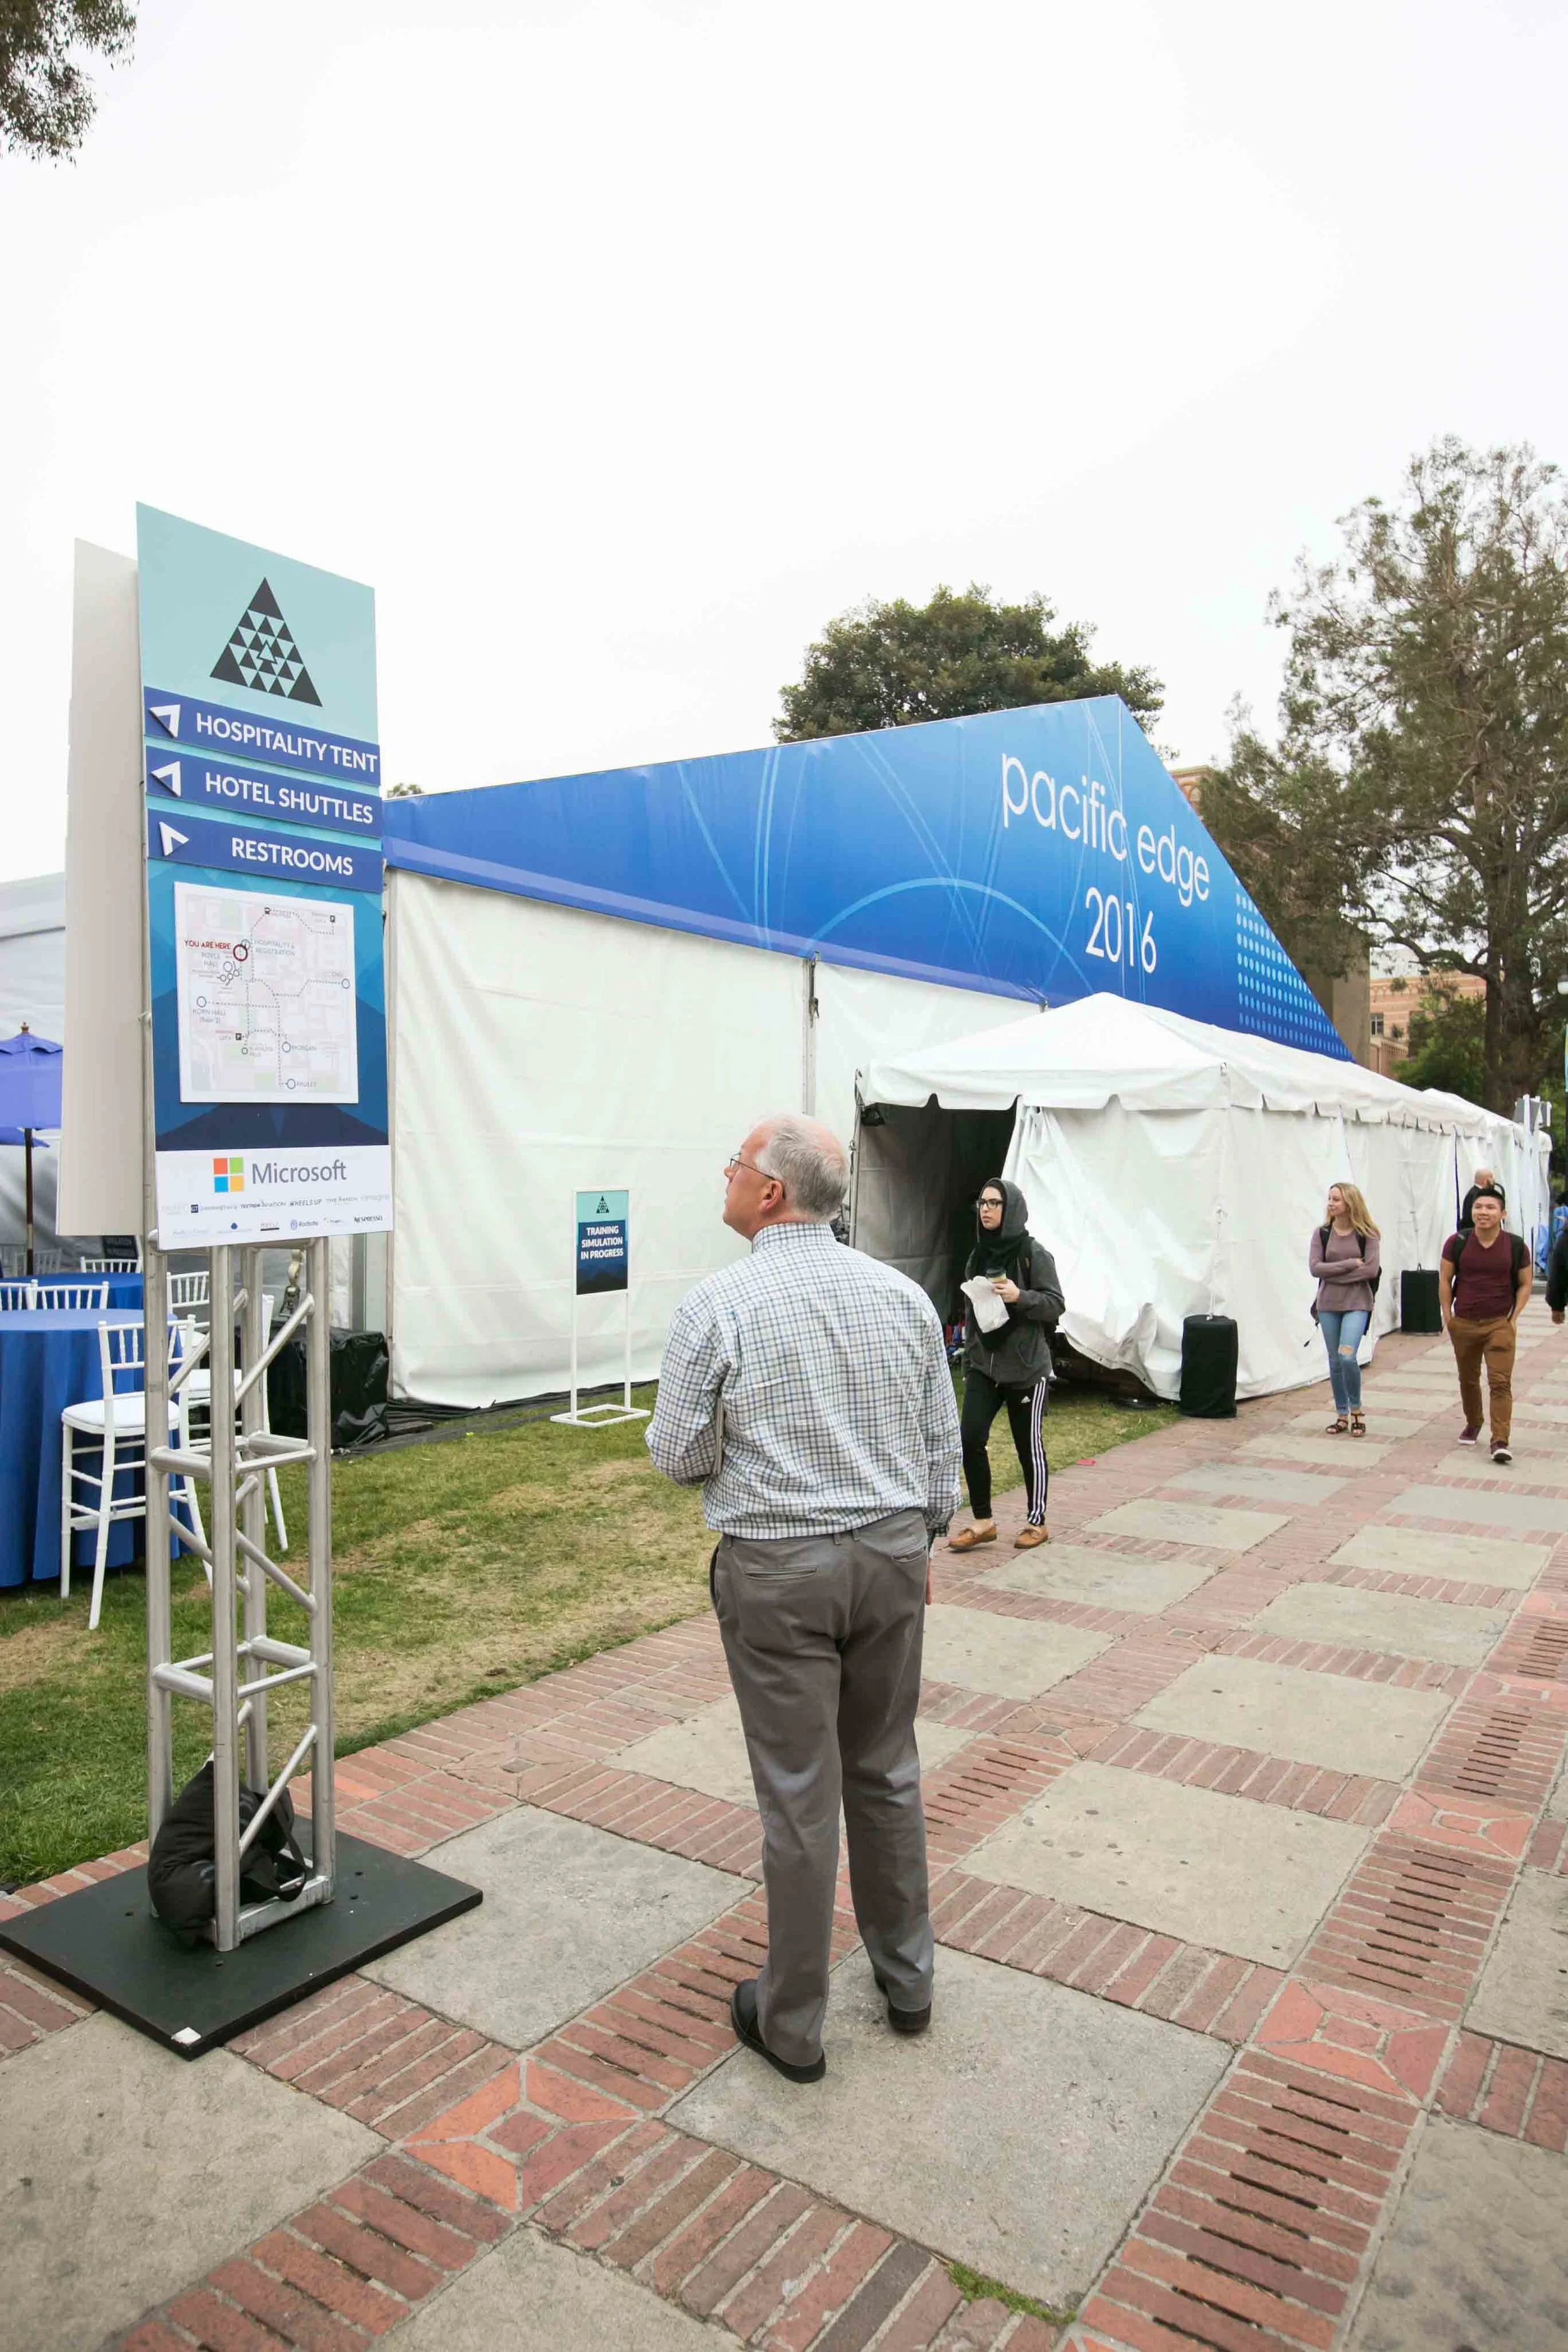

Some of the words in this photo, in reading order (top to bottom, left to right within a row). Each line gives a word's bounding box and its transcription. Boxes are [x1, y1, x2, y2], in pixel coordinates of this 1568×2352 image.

[196, 712, 327, 761] HOSPITALITY
[329, 744, 378, 772] TENT
[206, 772, 275, 805] HOTEL
[279, 788, 373, 824] SHUTTLES
[1002, 753, 1127, 861] pacific
[1136, 824, 1210, 908] edge
[231, 837, 353, 876] RESTROOMS
[1085, 887, 1157, 973] 2016
[252, 1159, 346, 1184] Microsoft
[581, 1237, 623, 1248] SIMULATION
[586, 1226, 619, 1236] TRAINING
[581, 1251, 588, 1259] IN
[590, 1248, 623, 1259] PROGRESS
